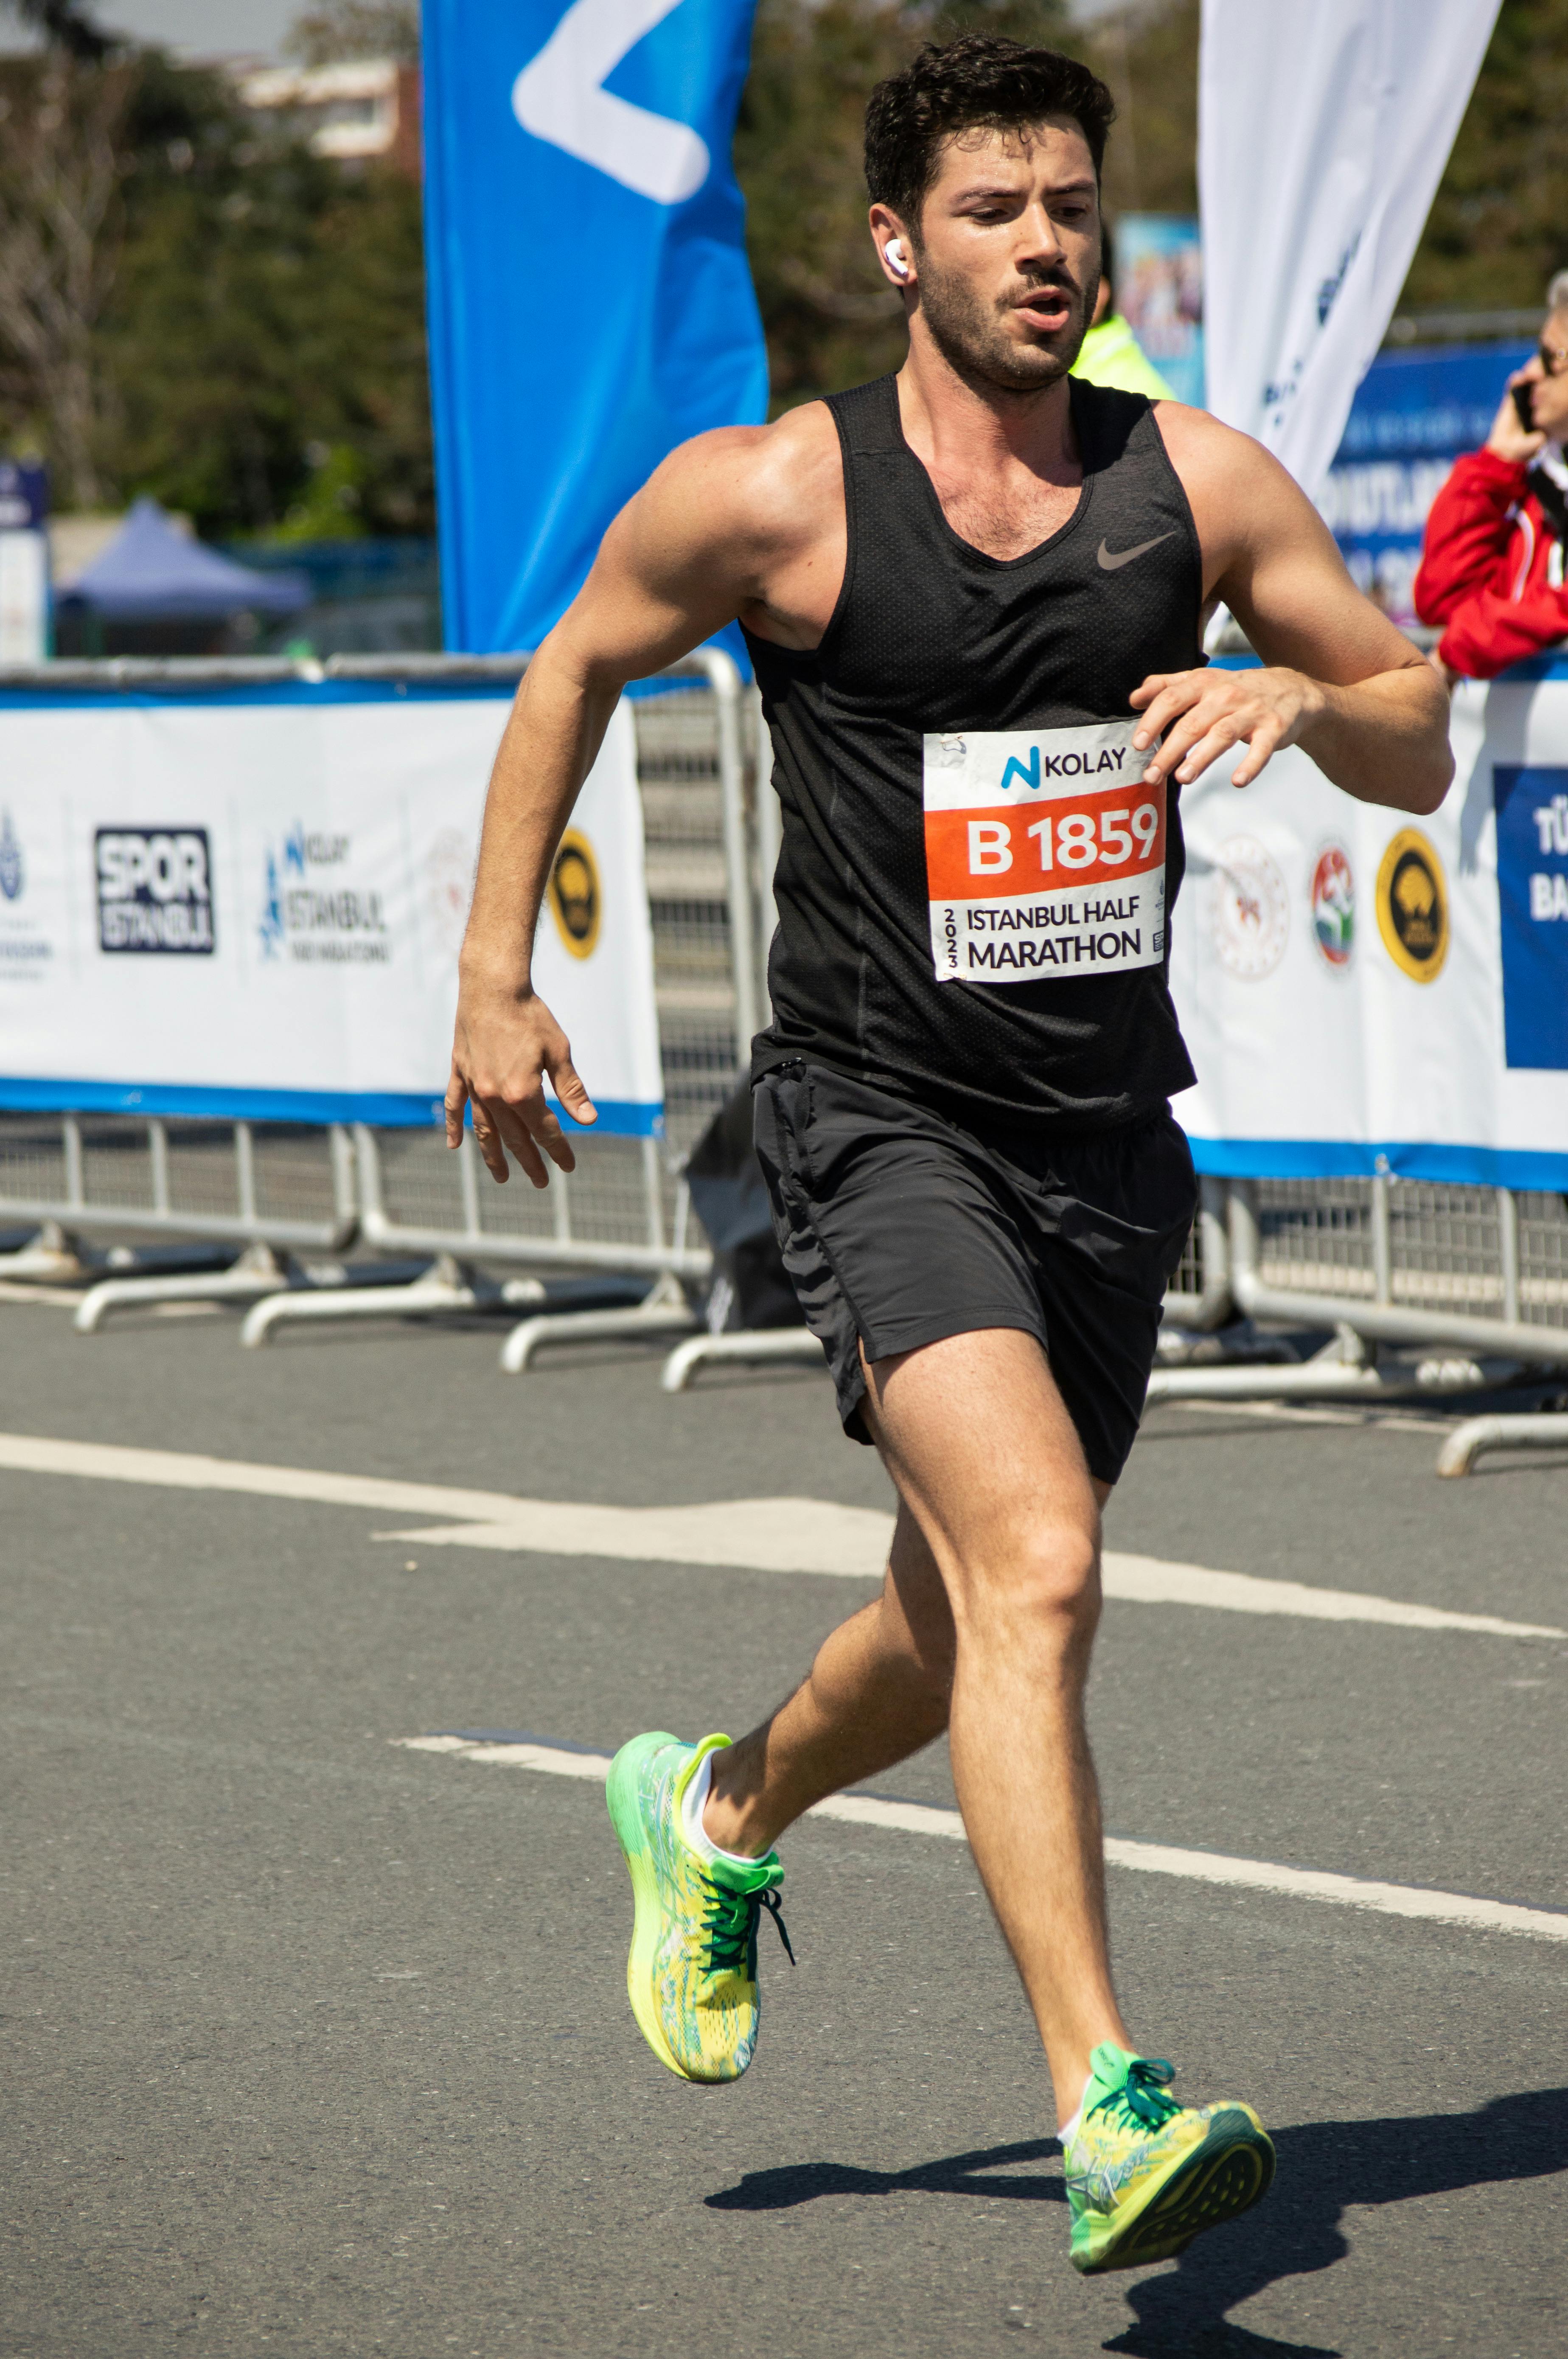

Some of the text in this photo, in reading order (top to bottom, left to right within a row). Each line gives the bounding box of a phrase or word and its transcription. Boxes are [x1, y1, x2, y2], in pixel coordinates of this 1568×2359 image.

[1045, 747, 1127, 777] KOLAY
[968, 803, 1158, 874] B 1859
[99, 834, 209, 901] SPOR
[967, 904, 1080, 931] ISTANBUL
[1084, 896, 1140, 923] HALF
[944, 909, 958, 969] 2023
[968, 928, 1141, 969] MARATHON
